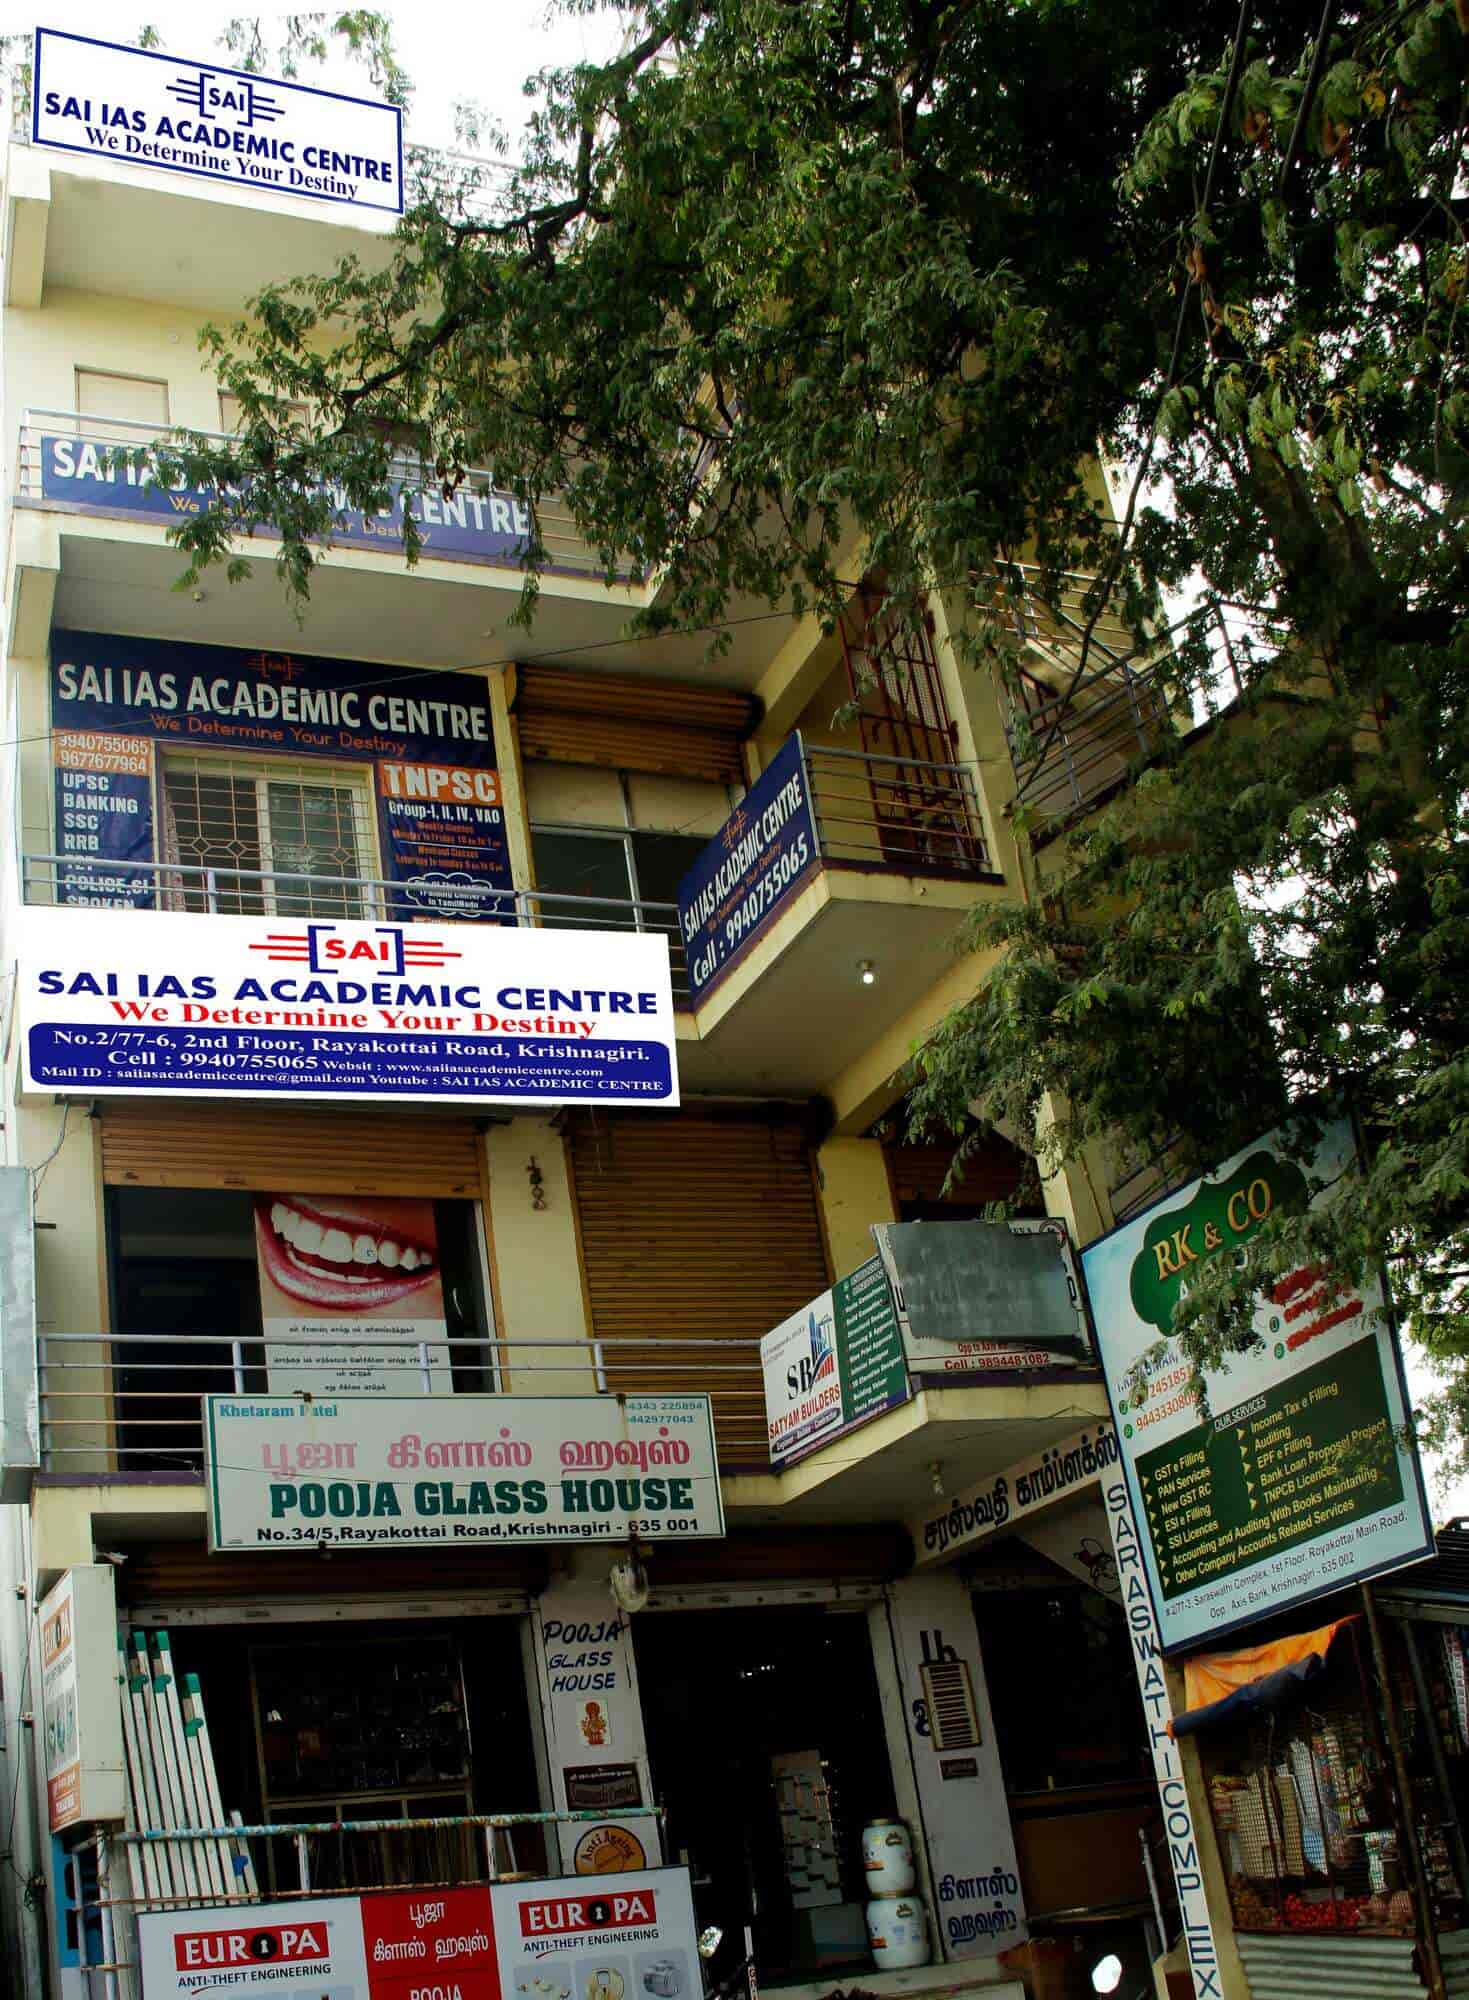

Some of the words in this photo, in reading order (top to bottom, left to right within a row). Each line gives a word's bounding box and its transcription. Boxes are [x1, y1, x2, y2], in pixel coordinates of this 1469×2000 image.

[209, 87, 245, 111] SAI
[45, 92, 92, 123] SAI
[102, 103, 147, 133] IAS
[155, 116, 295, 164] ACADEMIC
[303, 145, 393, 183] CENTRE
[84, 126, 119, 150] We
[125, 134, 231, 173] Determine
[238, 156, 283, 184] Your
[289, 167, 359, 200] Destiny
[168, 495, 201, 513] We
[58, 663, 113, 704] SAI
[122, 669, 179, 711] IAS
[186, 675, 361, 729] ACADEMIC
[367, 695, 489, 742] CENTRE
[150, 713, 181, 731] We
[188, 716, 286, 742] Determine
[289, 727, 331, 746] Your
[339, 731, 407, 755] Destiny
[63, 773, 109, 791] UPSC
[384, 764, 497, 803] TNPSC
[63, 792, 139, 815] BANKING
[475, 808, 501, 824] VAO
[63, 813, 99, 830] SSC
[63, 833, 100, 851] RRB
[684, 901, 702, 943] SAI
[699, 882, 717, 924] IAS
[713, 820, 764, 907] ACADEMIC
[762, 771, 803, 844] CENTRE
[693, 934, 717, 988] Cell
[725, 831, 809, 948] 9940755065
[324, 937, 389, 962] SAI
[38, 970, 118, 997] SAI
[138, 974, 218, 1000] IAS
[233, 977, 482, 1010] ACADEMIC
[496, 986, 658, 1015] CENTRE
[110, 1000, 169, 1022] We
[183, 1002, 368, 1030] Determine
[379, 1010, 462, 1032] Your
[472, 1012, 597, 1040] Destiny
[53, 1030, 176, 1051] No.2/77-6,
[184, 1033, 229, 1050] 2nd
[237, 1035, 305, 1053] Floor,
[311, 1037, 438, 1057] Rayakottai
[445, 1041, 512, 1059] Road,
[518, 1044, 650, 1063] Krishnagiri.
[41, 1066, 76, 1078] Mail
[80, 1067, 102, 1079] ID
[116, 1068, 367, 1085] saiiasacademiccentre@gmail.com
[369, 1074, 430, 1087] Youtube
[440, 1076, 469, 1088] SAI
[473, 1077, 501, 1089] IAS
[504, 1077, 595, 1091] ACADEMIC
[597, 1079, 665, 1092] CENTRE
[107, 1051, 156, 1067] Cell
[180, 1053, 320, 1071] 9940755065
[322, 1060, 373, 1072] Websit
[386, 1063, 604, 1078] www.saiiasacademiccentre.com
[1151, 1223, 1200, 1281] RK
[1203, 1221, 1224, 1250] &
[1226, 1176, 1274, 1234] CO
[219, 1404, 294, 1418] Khetaram
[768, 1407, 800, 1440] SATYAM
[799, 1383, 841, 1423] BUILDERS
[1250, 1409, 1285, 1434] Income
[1283, 1399, 1302, 1418] Tax
[1309, 1381, 1340, 1405] Filling
[1254, 1425, 1293, 1450] Auditing
[1256, 1452, 1277, 1470] EPF
[1283, 1433, 1314, 1456] Filling
[1259, 1467, 1284, 1489] Bank
[1283, 1457, 1309, 1477] Loan
[1350, 1416, 1389, 1445] Project
[262, 1441, 358, 1481] பூஜா
[386, 1427, 533, 1469] கிளாஸ்
[559, 1426, 690, 1478] ஹவுஸ்
[1153, 1462, 1174, 1482] GST
[1178, 1450, 1207, 1471] Filling
[270, 1482, 401, 1518] POOJA
[414, 1479, 548, 1516] GLASS
[561, 1477, 695, 1513] HOUSE
[1157, 1480, 1176, 1499] PAN
[1175, 1466, 1213, 1490] Services
[1263, 1481, 1297, 1505] TNPCB
[1296, 1463, 1339, 1490] Licences
[1160, 1498, 1179, 1515] New
[1178, 1488, 1200, 1508] GST
[1198, 1482, 1213, 1499] RC
[256, 1524, 447, 1542] No.34/5,Rayakottai
[453, 1521, 611, 1538] Road,Krishnagiri
[628, 1519, 662, 1533] 635
[667, 1519, 699, 1532] 001
[1163, 1515, 1180, 1534] ESI
[1186, 1504, 1213, 1525] Filling
[1172, 1537, 1218, 1568] Accounting
[1217, 1528, 1235, 1549] and
[1233, 1512, 1272, 1541] Auditing
[1270, 1504, 1292, 1523] With
[1291, 1491, 1323, 1517] Books
[1355, 1522, 1378, 1541] Main
[1167, 1532, 1183, 1551] SSI
[1182, 1521, 1221, 1545] Licences
[1175, 1565, 1198, 1585] Other
[1198, 1549, 1237, 1575] Company
[1236, 1533, 1278, 1561] Accounts
[1277, 1516, 1314, 1541] Related
[1312, 1498, 1355, 1526] Services
[543, 1619, 620, 1646] POOJA
[548, 1651, 614, 1671] GLASS
[551, 1672, 617, 1694] HOUSE
[581, 1832, 603, 1862] Anti
[1161, 1782, 1222, 1999] COMPLEX
[409, 1900, 446, 1929] பூஜா
[371, 1936, 427, 1964] கிளாஸ்
[434, 1933, 490, 1964] ஹவுஸ்
[523, 1935, 586, 1953] ANTI-THEFT
[588, 1927, 660, 1946] ENGINEERING
[178, 1972, 248, 1990] ANTI-THEFT
[250, 1963, 332, 1984] ENGINEERING
